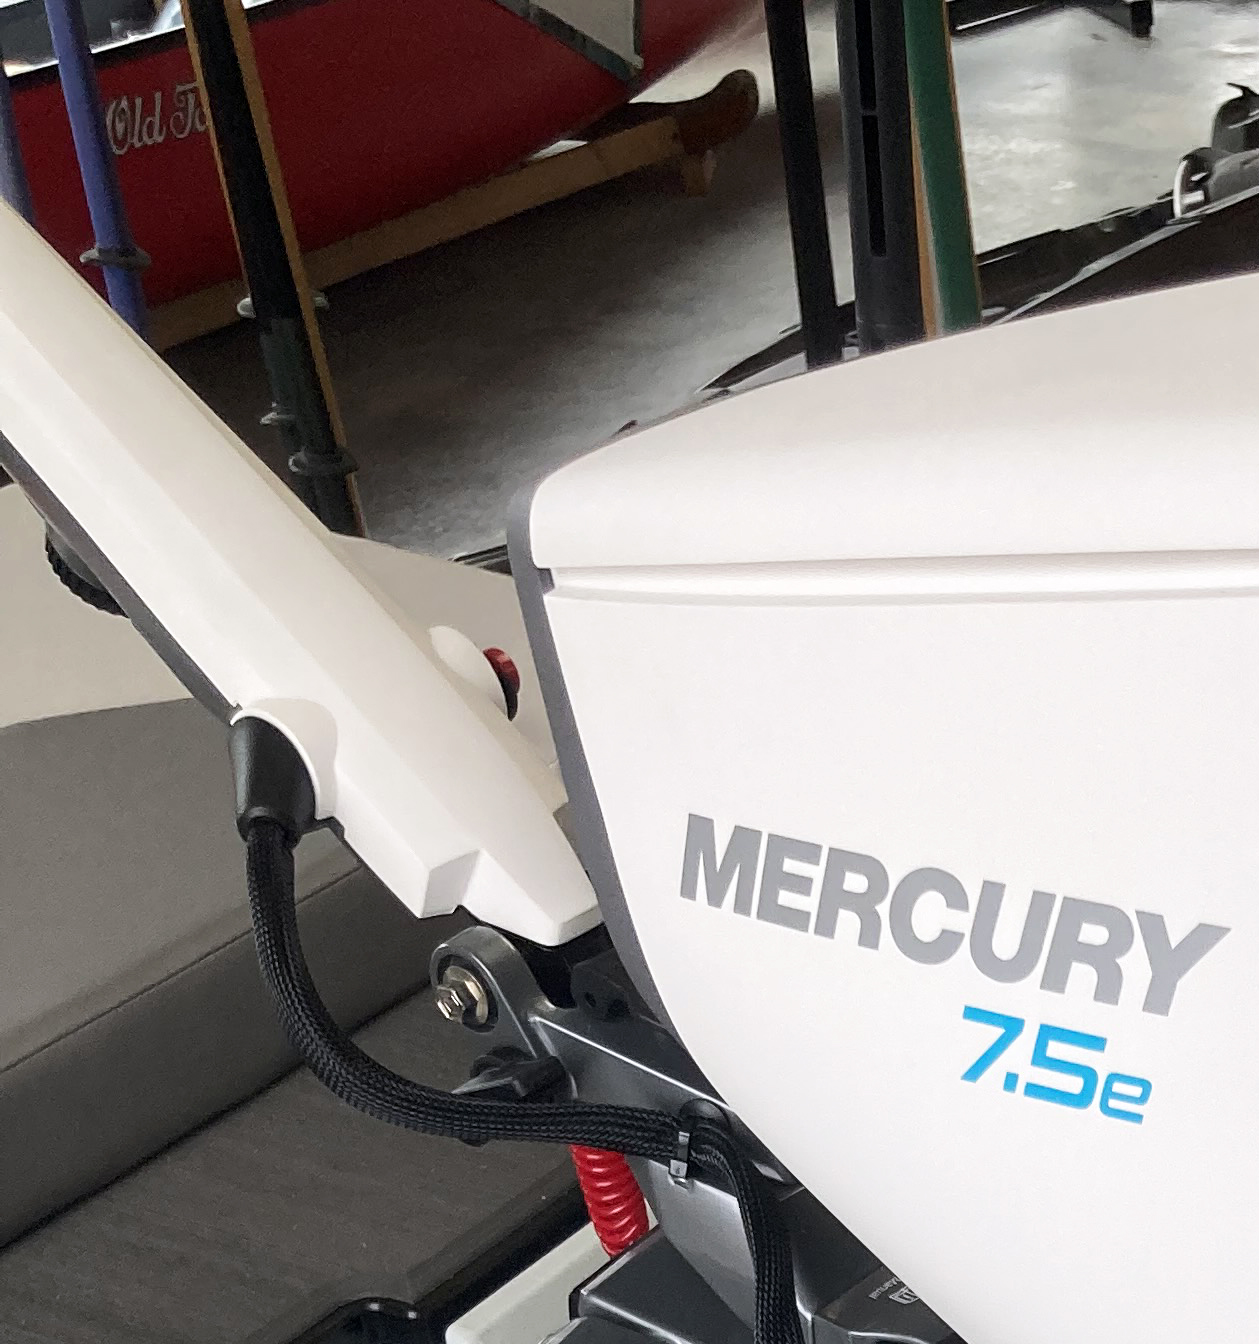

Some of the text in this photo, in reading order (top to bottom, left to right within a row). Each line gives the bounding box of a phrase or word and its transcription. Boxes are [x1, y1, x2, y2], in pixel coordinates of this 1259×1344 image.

[106, 92, 166, 155] Old
[679, 813, 1232, 1017] MERCURY
[959, 1005, 1153, 1125] 7.5e
